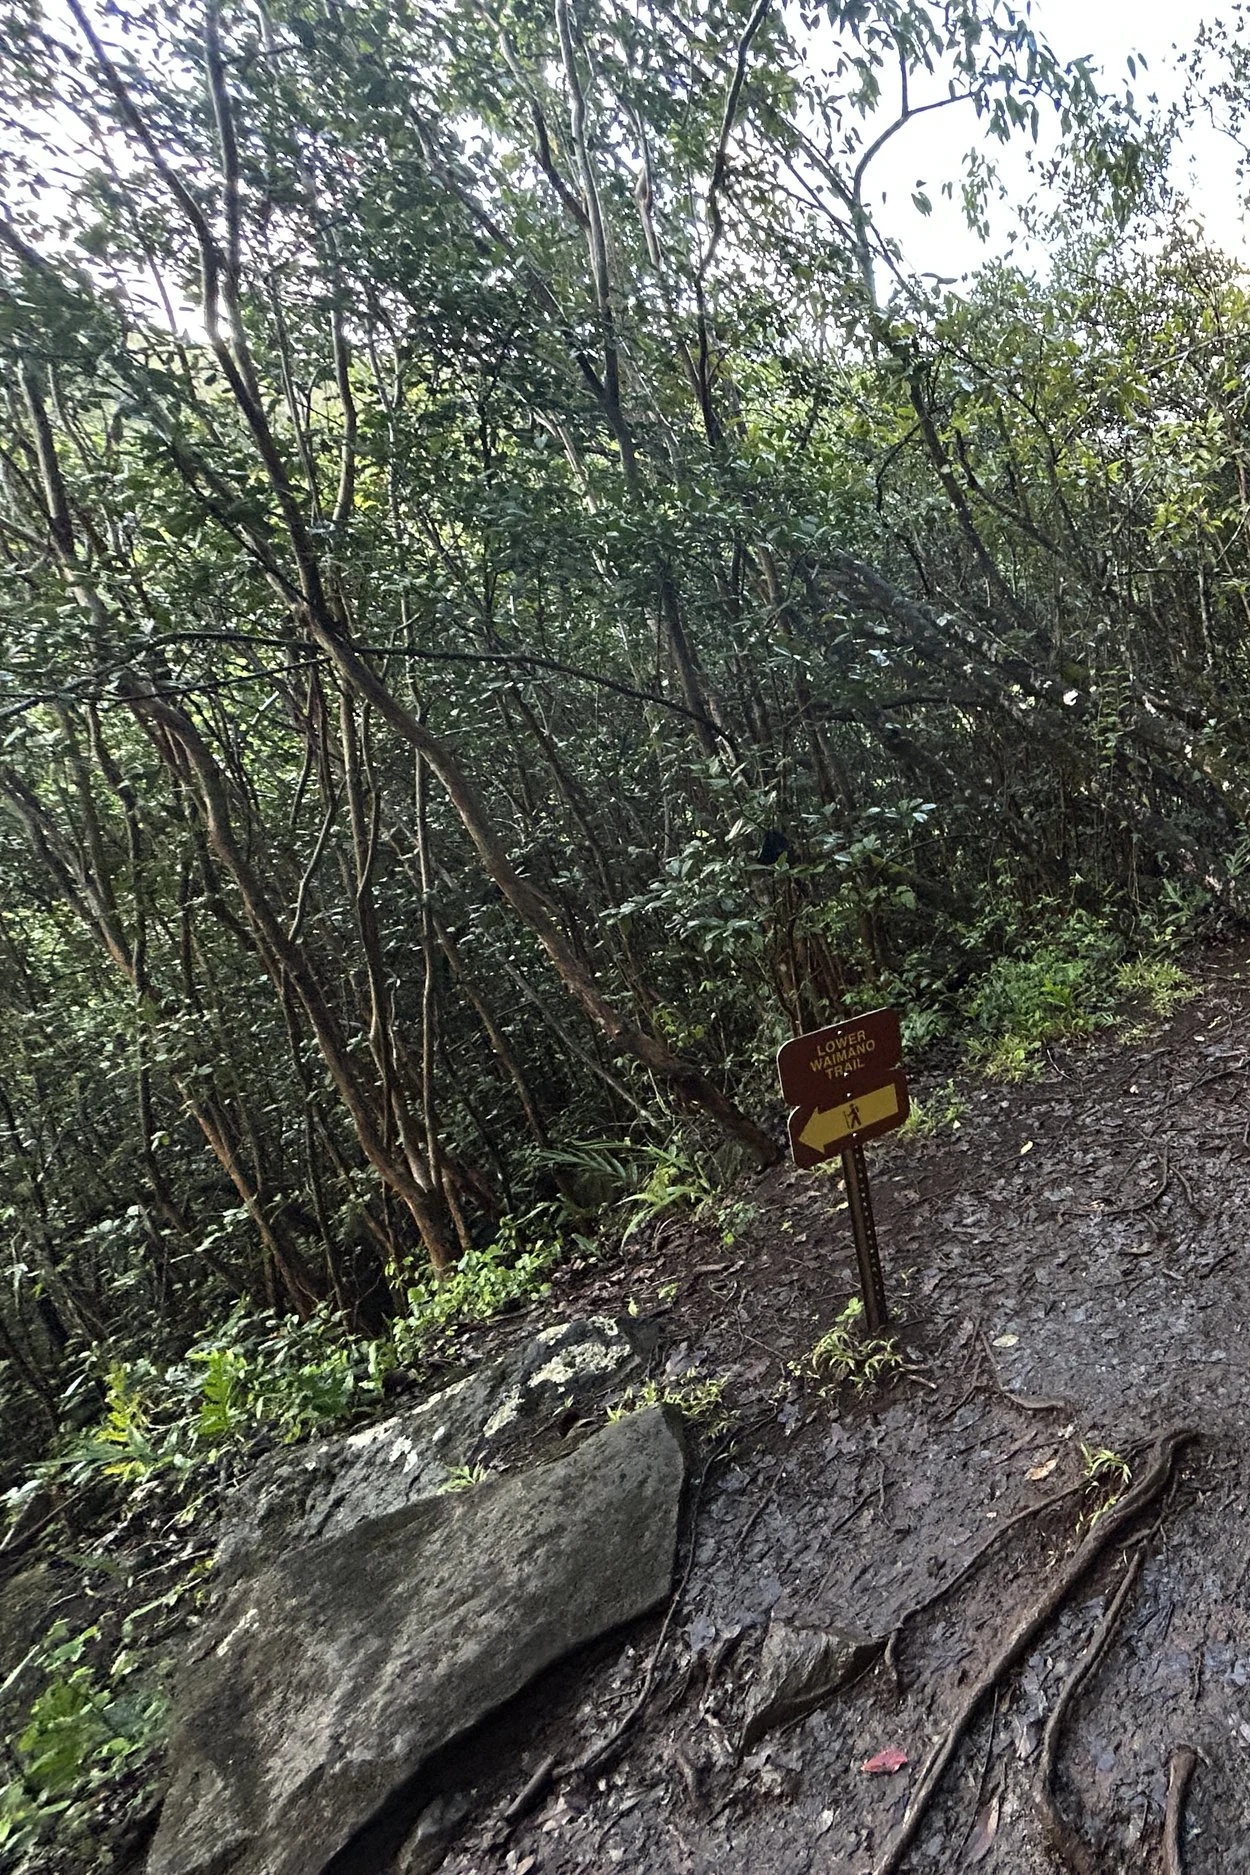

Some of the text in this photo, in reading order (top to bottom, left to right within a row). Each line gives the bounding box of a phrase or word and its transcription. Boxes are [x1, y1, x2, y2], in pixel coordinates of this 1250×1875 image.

[810, 1039, 876, 1072] WAIMANO
[817, 1030, 866, 1056] LOWER
[825, 1058, 865, 1080] TRAIL
